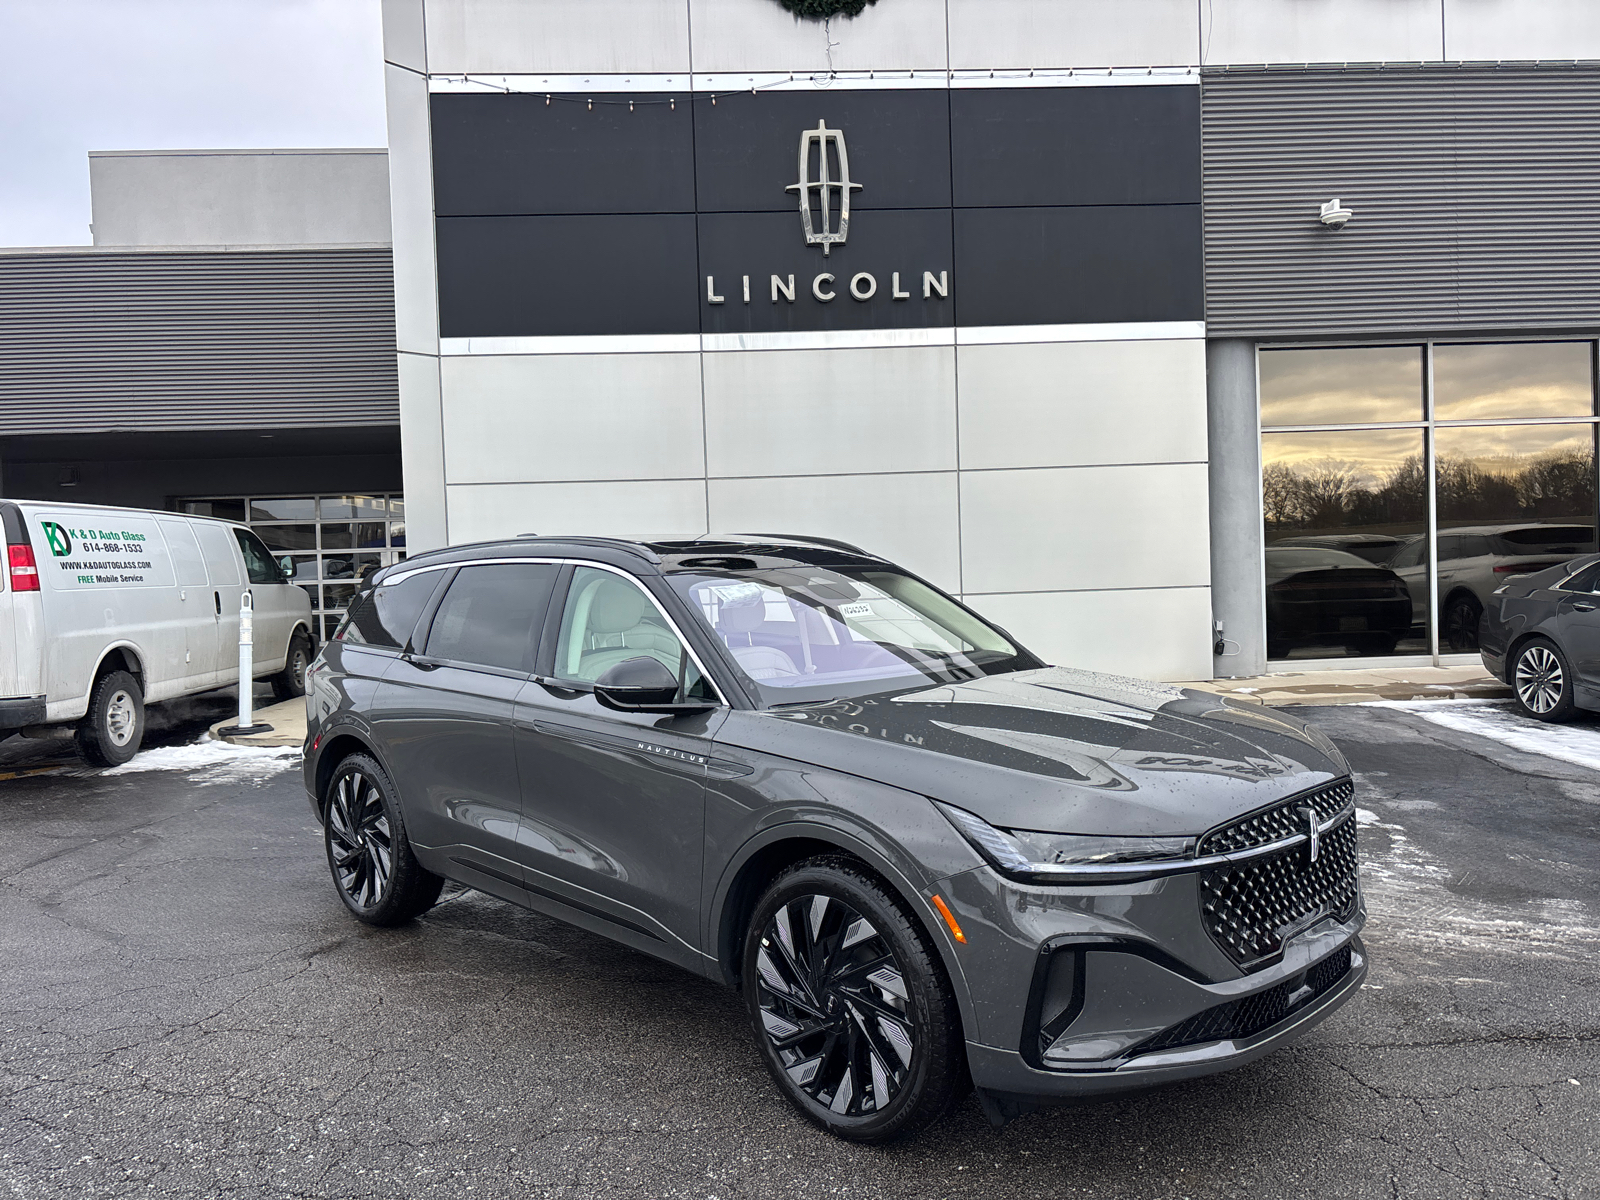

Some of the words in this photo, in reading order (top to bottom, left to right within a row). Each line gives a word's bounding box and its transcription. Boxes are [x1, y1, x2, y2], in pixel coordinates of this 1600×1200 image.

[707, 270, 948, 304] LINCOLN
[68, 528, 78, 539] K
[79, 529, 88, 539] &
[88, 529, 97, 540] D
[99, 530, 120, 541] Auto
[121, 531, 146, 541] Glass
[82, 542, 143, 553] 614-868-1533
[60, 561, 152, 570] WWW.K&DAUTOGLASS.COM
[77, 575, 95, 584] FREE
[96, 574, 119, 583] Mobile
[120, 574, 144, 582] Service
[637, 743, 704, 763] NAUTILUS
